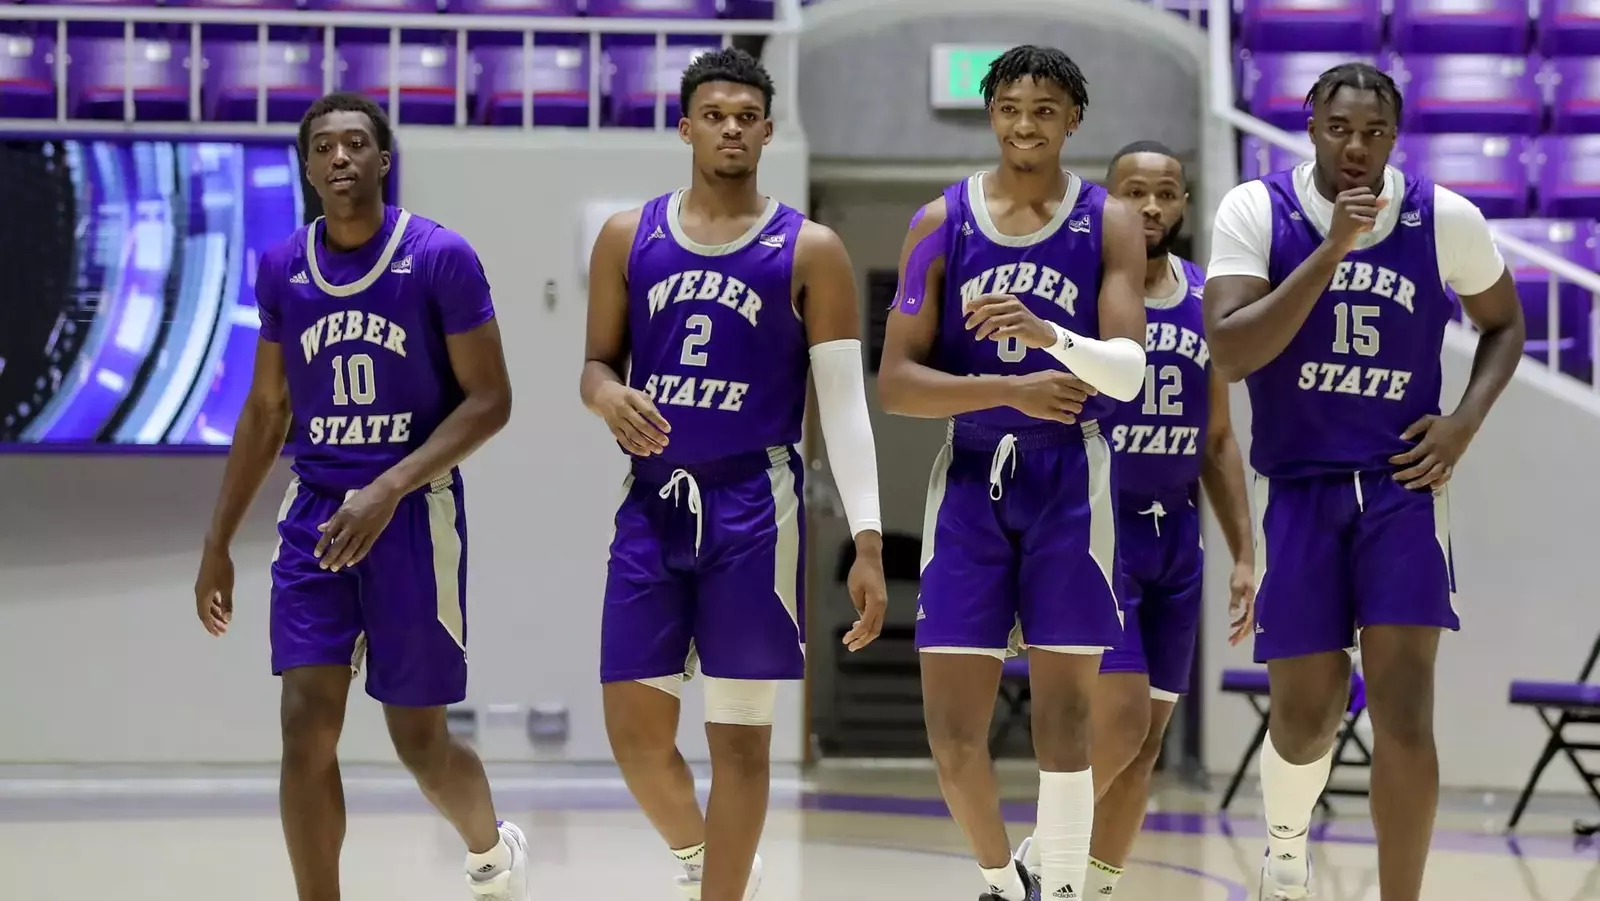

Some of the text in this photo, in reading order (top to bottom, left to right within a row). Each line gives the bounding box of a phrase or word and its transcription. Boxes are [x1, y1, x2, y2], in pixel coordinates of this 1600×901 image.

[647, 269, 763, 327] WEBER
[960, 261, 1079, 318] WEBER
[1329, 261, 1416, 314] EBER
[300, 310, 407, 364] WEBER
[680, 314, 713, 367] 2
[1145, 322, 1210, 371] EBER
[1332, 302, 1380, 357] 15
[331, 353, 376, 405] 10
[643, 373, 750, 412] STATE
[1142, 364, 1183, 416] 12
[1298, 362, 1412, 401] STATE
[309, 412, 413, 445] STATE
[1112, 424, 1200, 455] STATE
